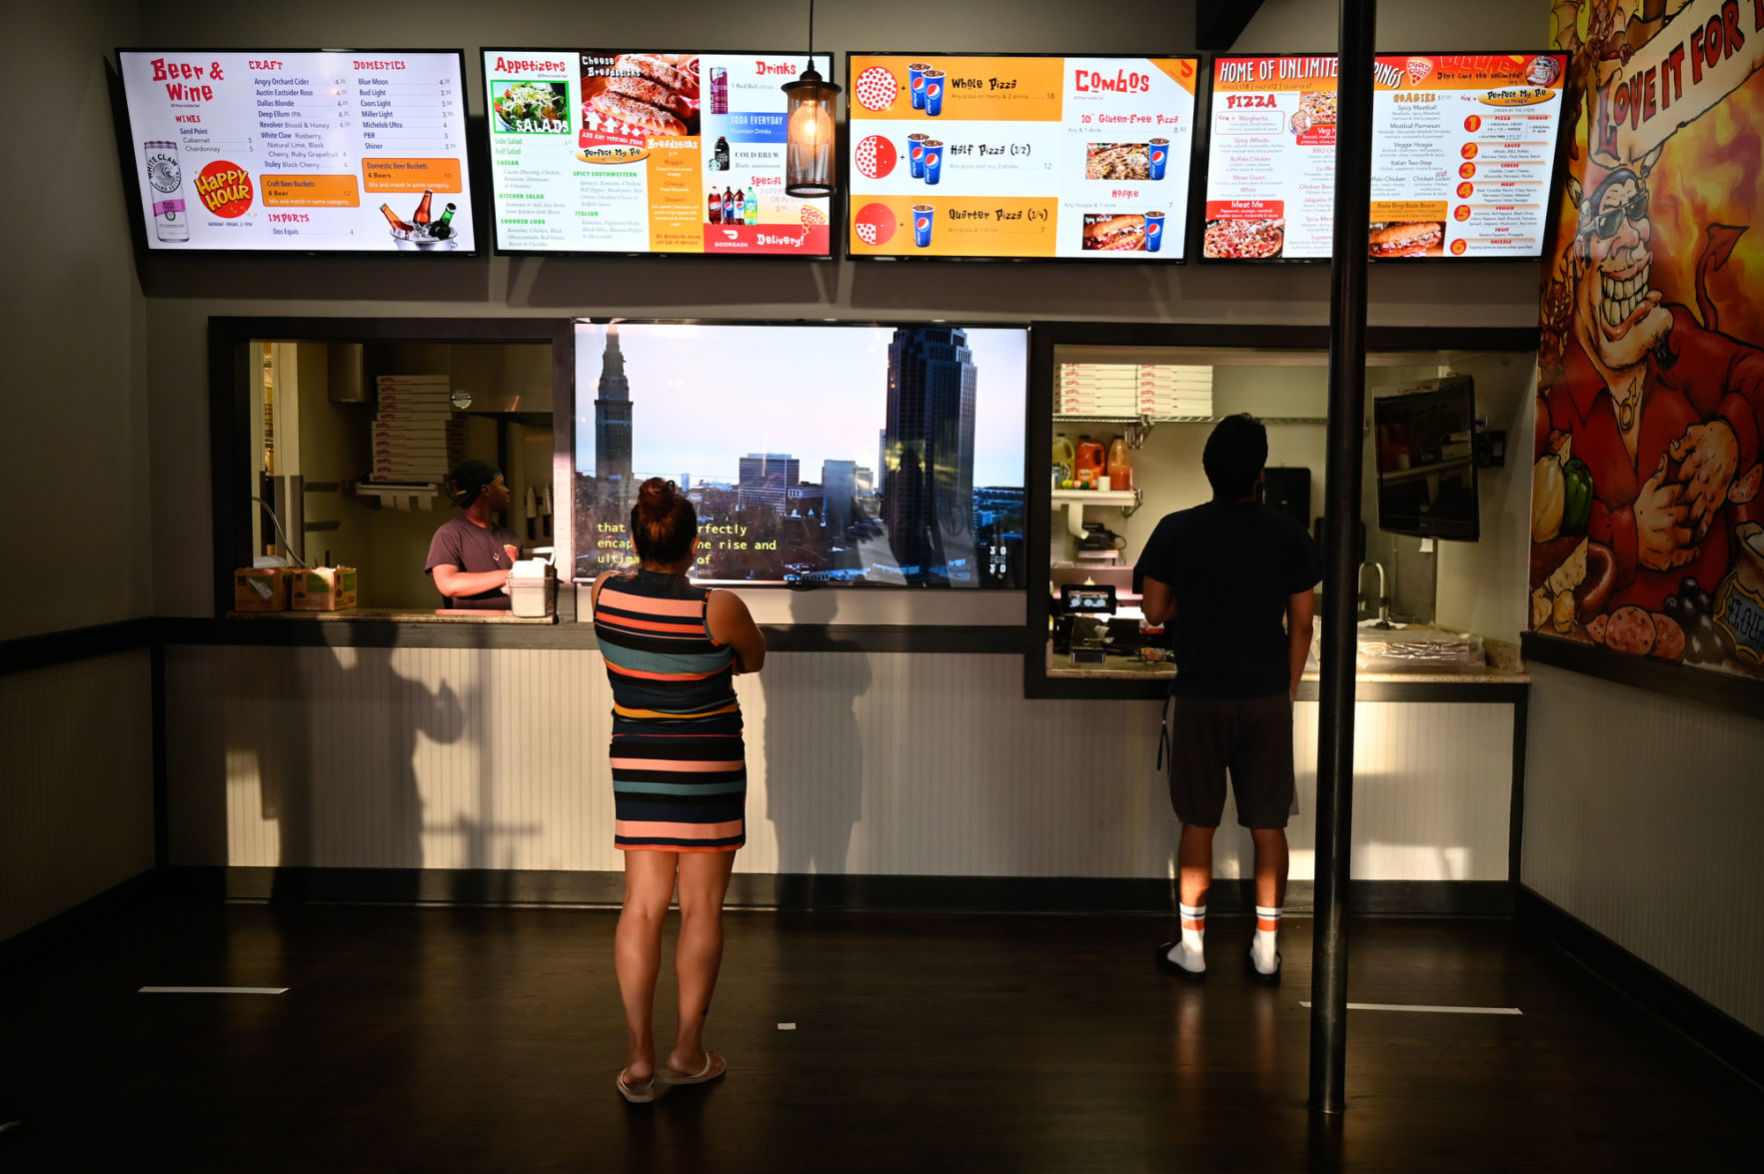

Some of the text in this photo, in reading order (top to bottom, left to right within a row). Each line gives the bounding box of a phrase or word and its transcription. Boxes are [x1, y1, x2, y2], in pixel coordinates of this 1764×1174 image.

[582, 56, 614, 65] Cheese
[1661, 42, 1685, 111] IT
[1691, 0, 1745, 85] FOR
[151, 58, 224, 81] Beer &
[248, 60, 283, 70] CRAFT
[353, 61, 406, 70] DOMESTICS
[495, 57, 566, 73] Appetizers
[756, 60, 796, 75] Drinks
[1220, 62, 1254, 82] HOME
[1260, 60, 1274, 80] OF
[1280, 58, 1338, 79] UNLIMITE
[1374, 61, 1406, 89] PINGS
[254, 78, 271, 87] Angry
[951, 78, 1017, 90] Whole Pizza
[166, 82, 214, 102] Wine
[377, 100, 391, 108] Light
[1227, 94, 1277, 108] PIZZA
[175, 115, 201, 123] WINES
[379, 111, 393, 119] Light
[750, 116, 783, 125] EVERYDAY
[1157, 114, 1179, 124] Pizza
[516, 119, 569, 132] SALADS
[950, 144, 974, 155] Half
[978, 144, 1005, 156] Pizza
[205, 185, 251, 211] HOUR
[268, 214, 310, 223] IMPORTS
[949, 208, 990, 220] Quarter
[995, 209, 1022, 221] Pizza
[757, 234, 804, 247] Delivery!
[598, 523, 748, 536] that rfectly
[697, 540, 712, 550] he
[719, 540, 748, 550] rise
[755, 540, 777, 550] and
[597, 554, 711, 564] ultima of
[1728, 594, 1764, 642] FLOU
